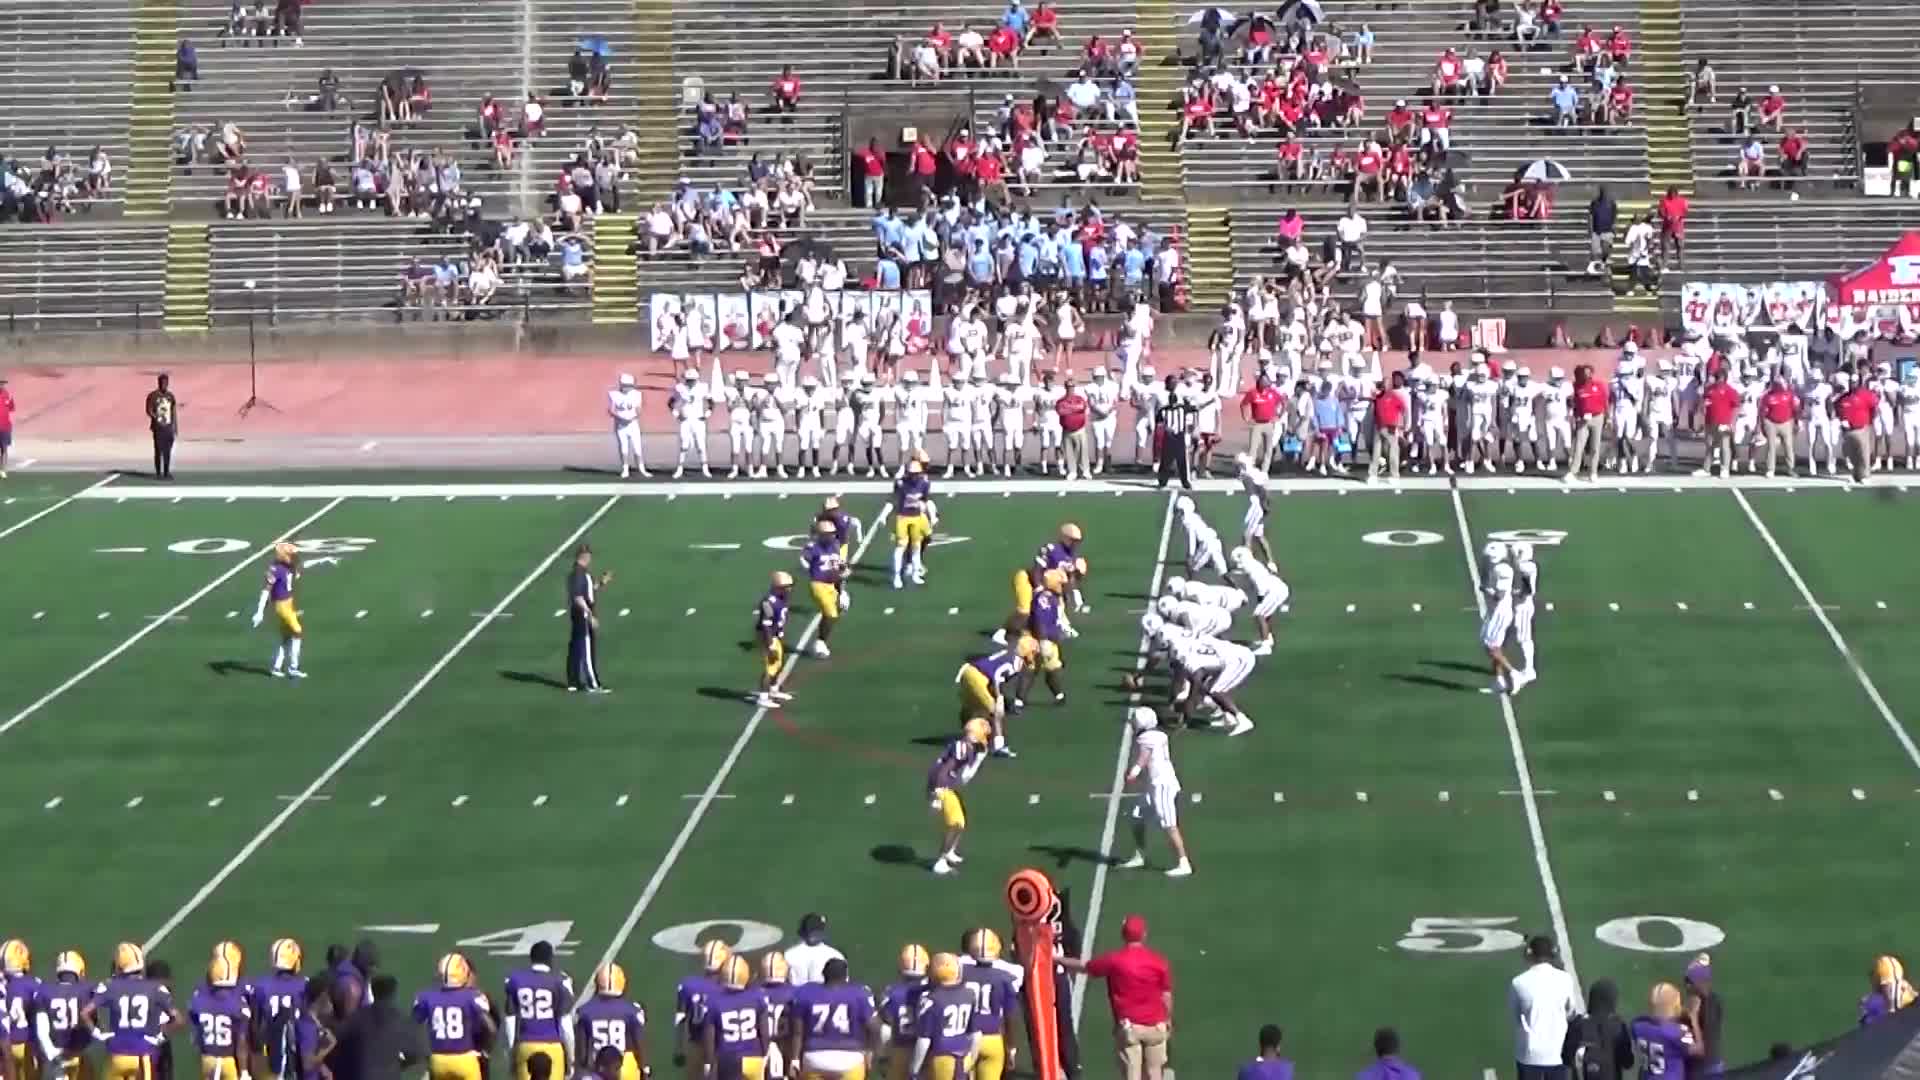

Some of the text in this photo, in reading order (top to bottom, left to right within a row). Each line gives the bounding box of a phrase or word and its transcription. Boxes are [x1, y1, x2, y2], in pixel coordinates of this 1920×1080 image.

[50, 997, 79, 1029] 31
[118, 995, 149, 1028] 13
[432, 1006, 465, 1040] 48
[721, 1008, 758, 1043] 52
[811, 1003, 851, 1034] 74
[942, 1003, 972, 1038] 30
